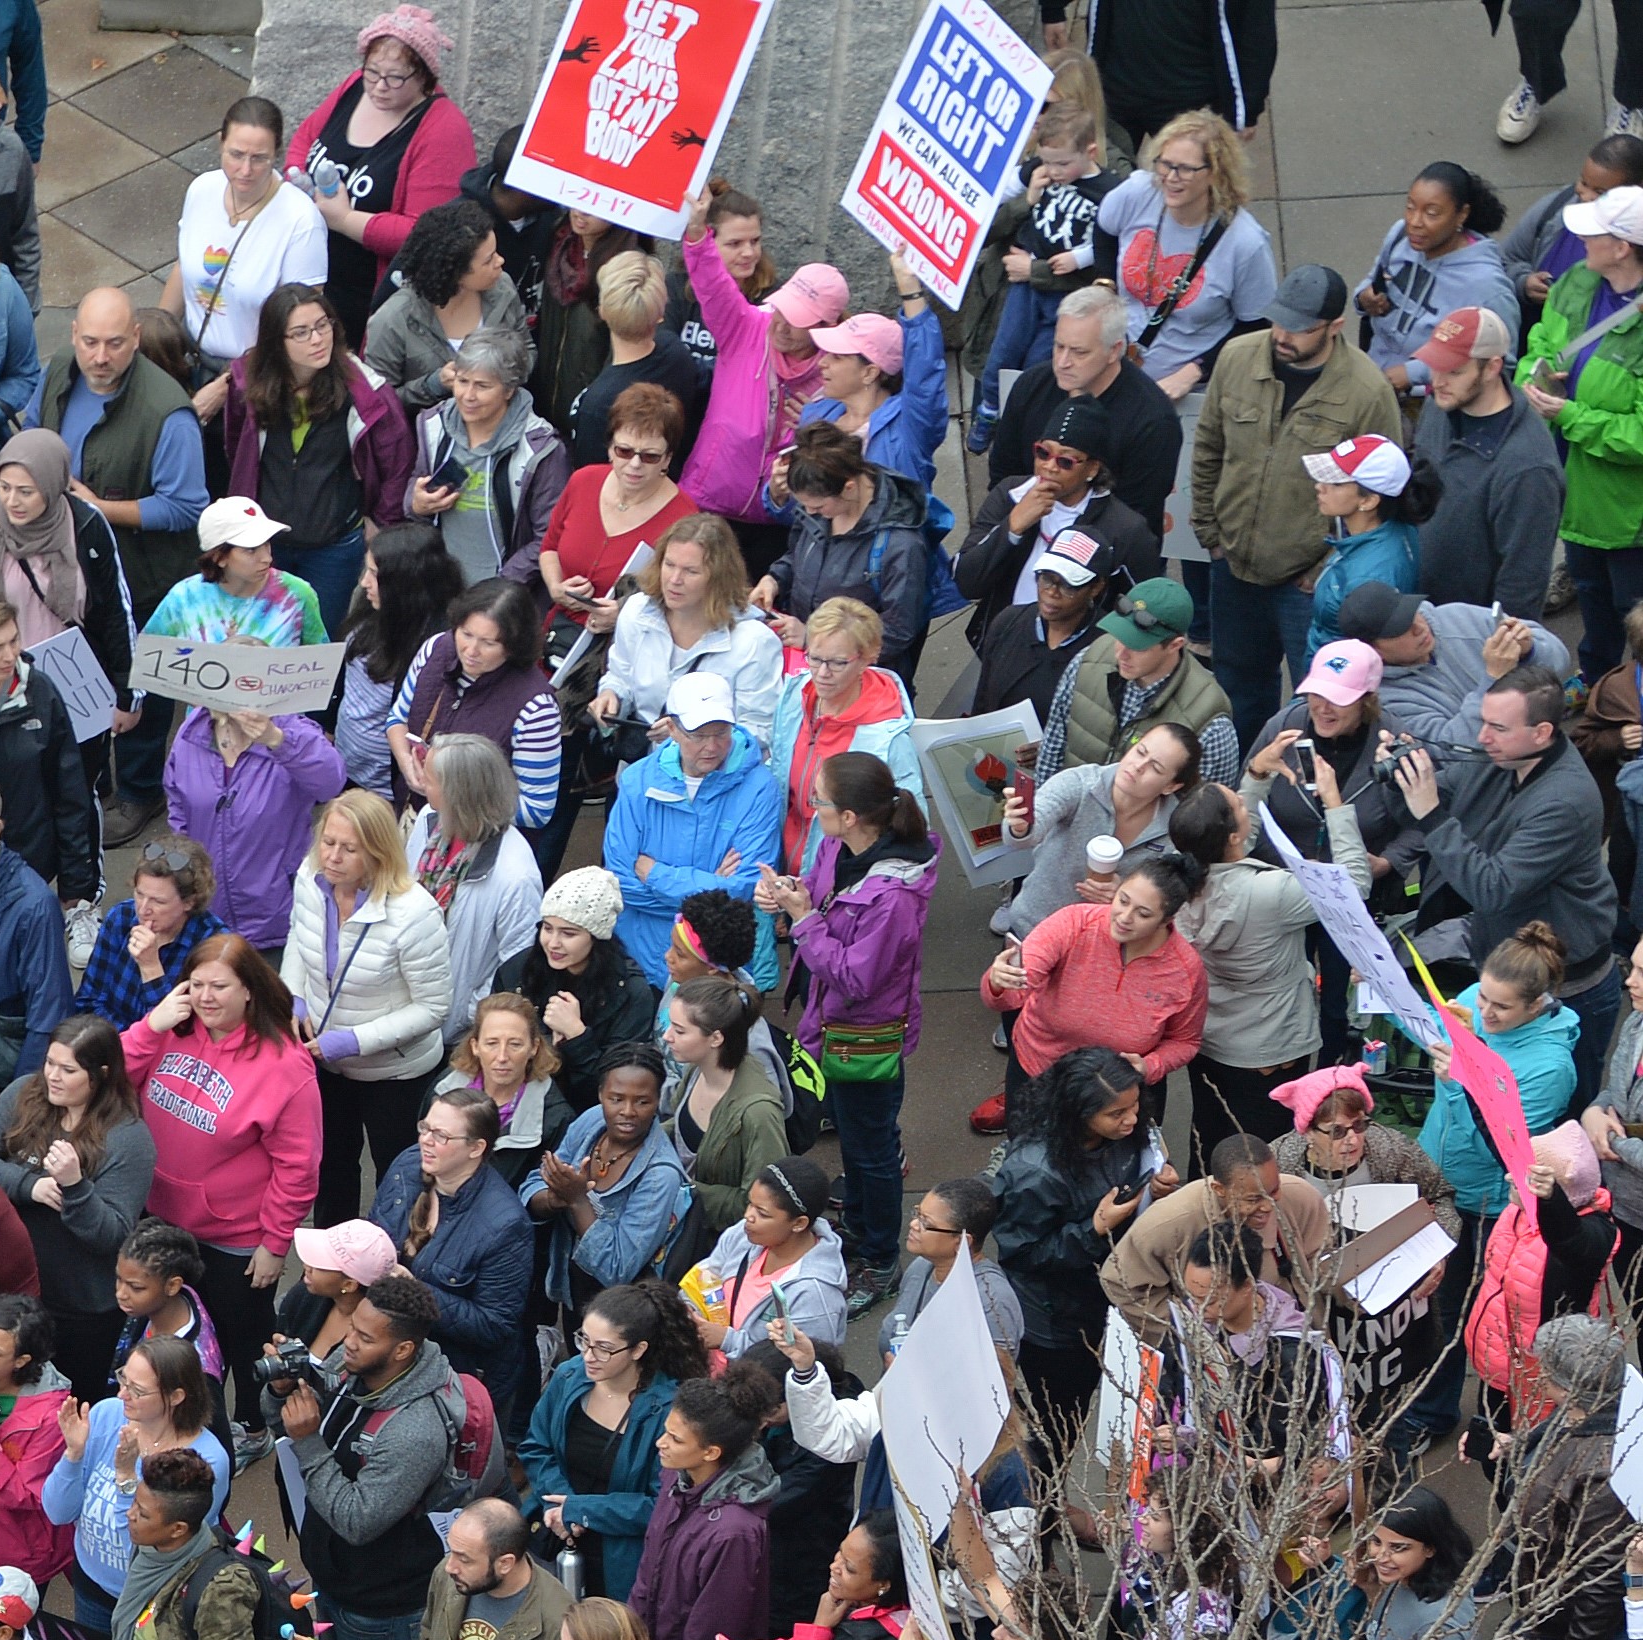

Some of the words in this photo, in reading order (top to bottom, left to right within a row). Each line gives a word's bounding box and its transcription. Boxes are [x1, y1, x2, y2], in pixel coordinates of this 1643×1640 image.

[614, 32, 677, 66] YOUR
[623, 0, 699, 40] GET
[598, 52, 678, 101] LAWS
[928, 20, 993, 101] LEFT
[985, 77, 1021, 132] OR
[589, 74, 641, 117] OFF
[620, 97, 677, 138] MY
[909, 65, 1007, 175] RIGHT
[585, 109, 649, 167] BODY
[898, 118, 916, 141] WE
[916, 134, 939, 166] CAN
[938, 157, 961, 189] ALL
[960, 187, 981, 206] SEE
[876, 146, 968, 255] WRONG
[933, 273, 954, 299] NC
[142, 650, 231, 690] 140
[266, 660, 325, 678] REAL
[146, 1077, 218, 1136] TRADITIONAL
[155, 1052, 234, 1113] ELIZABETH
